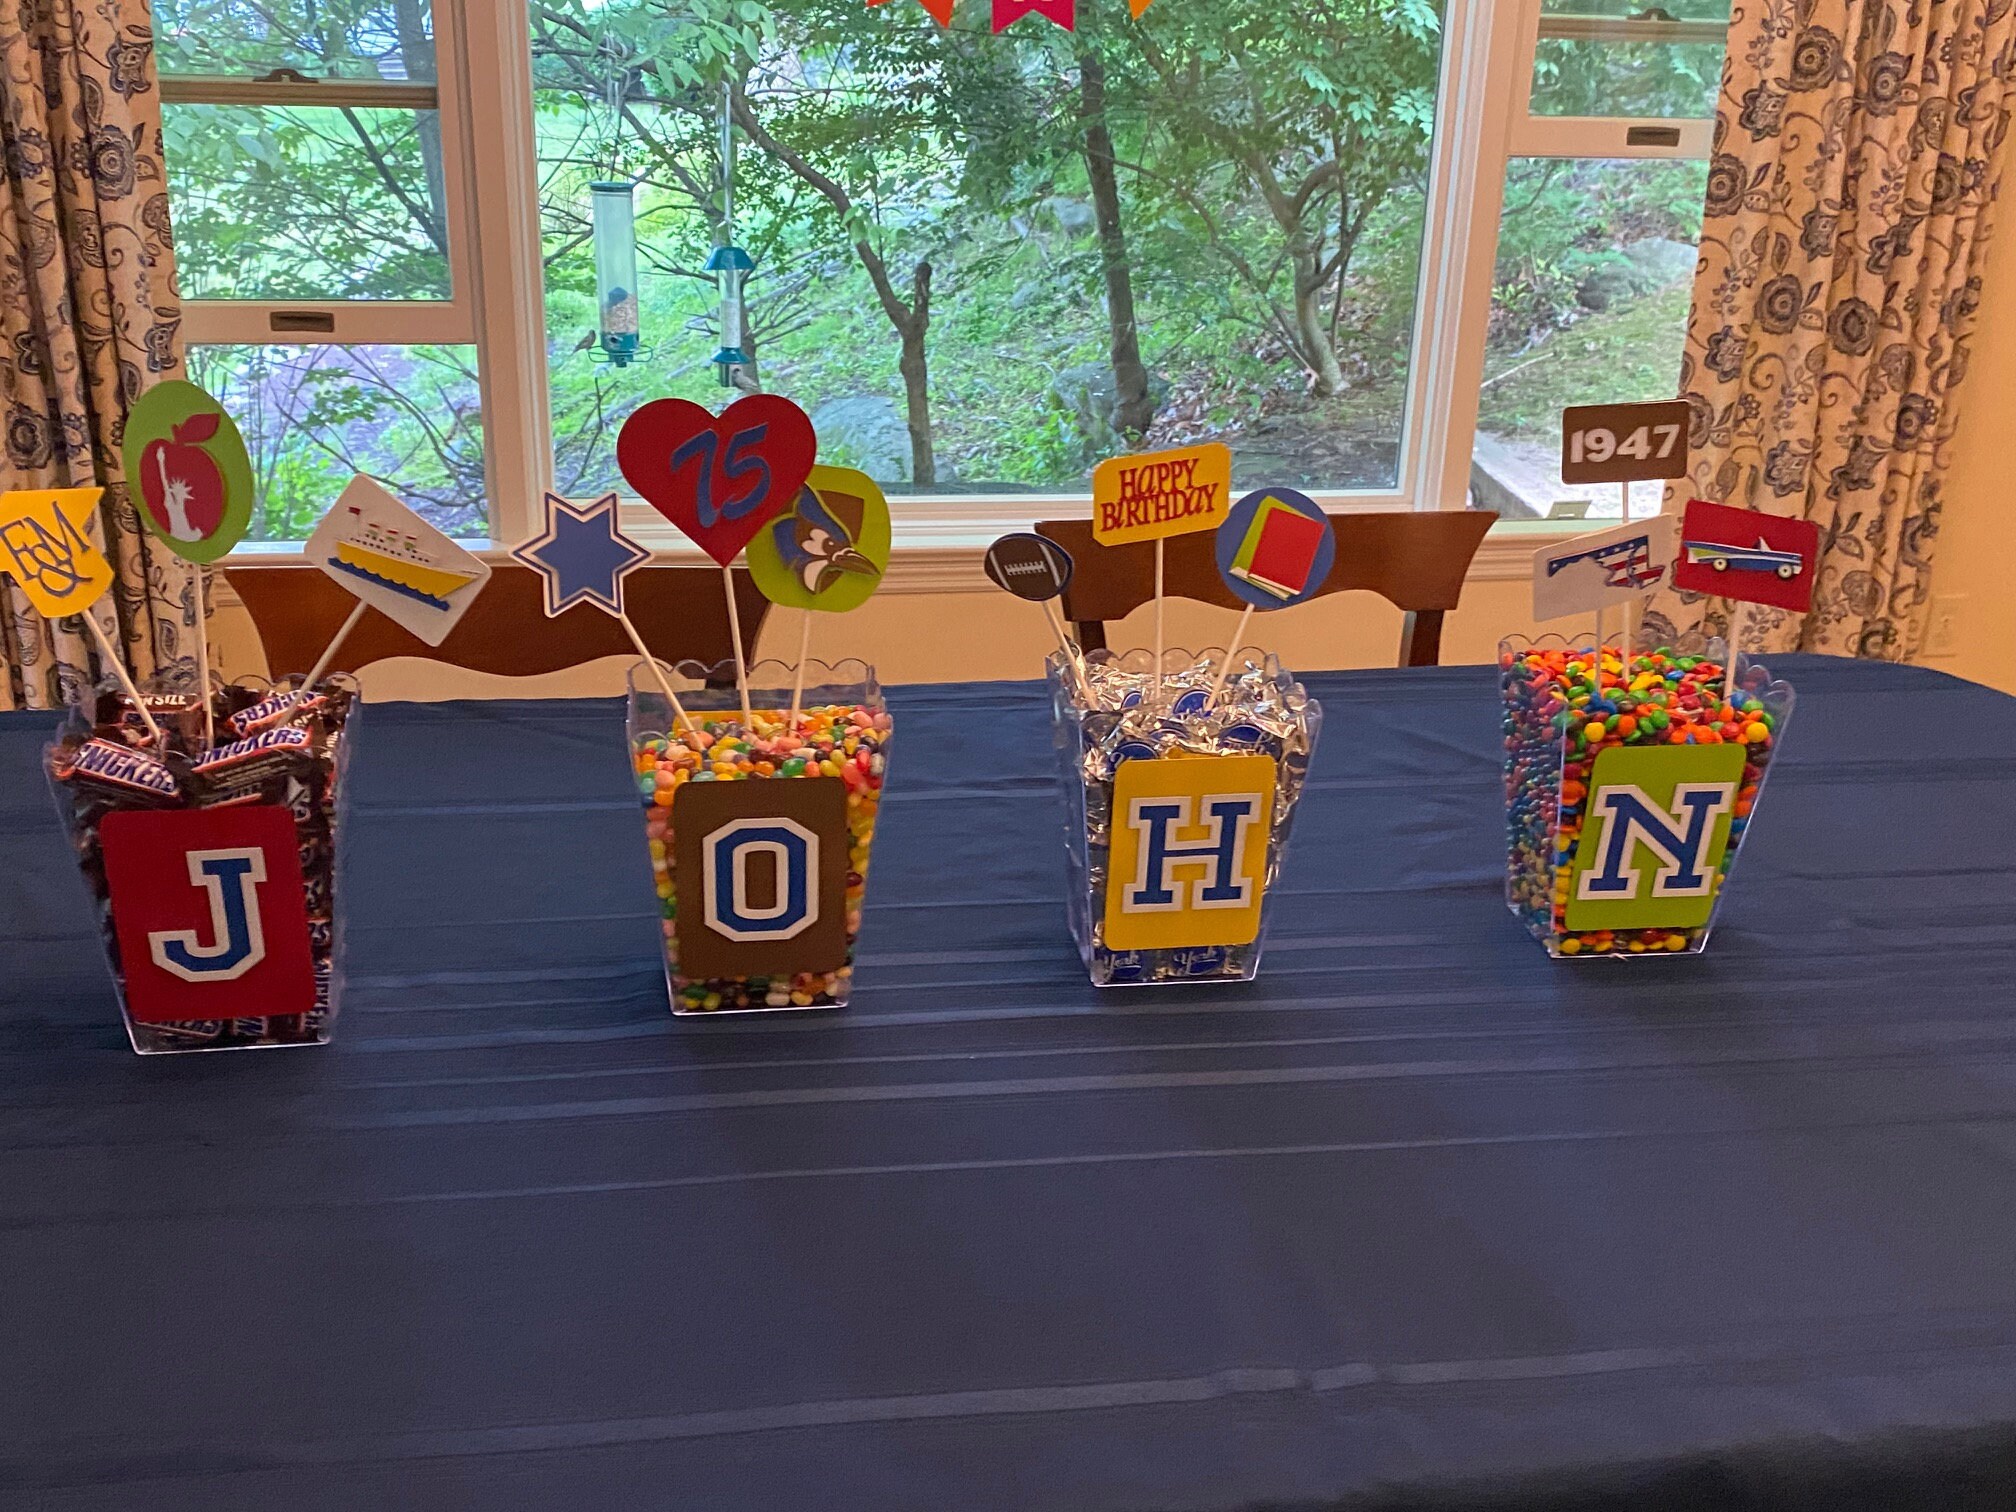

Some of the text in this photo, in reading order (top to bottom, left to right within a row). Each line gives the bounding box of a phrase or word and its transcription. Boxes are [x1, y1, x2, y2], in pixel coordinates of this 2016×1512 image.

[669, 422, 772, 528] 75
[1570, 424, 1680, 463] 1947
[703, 818, 819, 942] O
[1122, 793, 1263, 914] H
[1577, 782, 1736, 900] N
[147, 847, 267, 983] J
